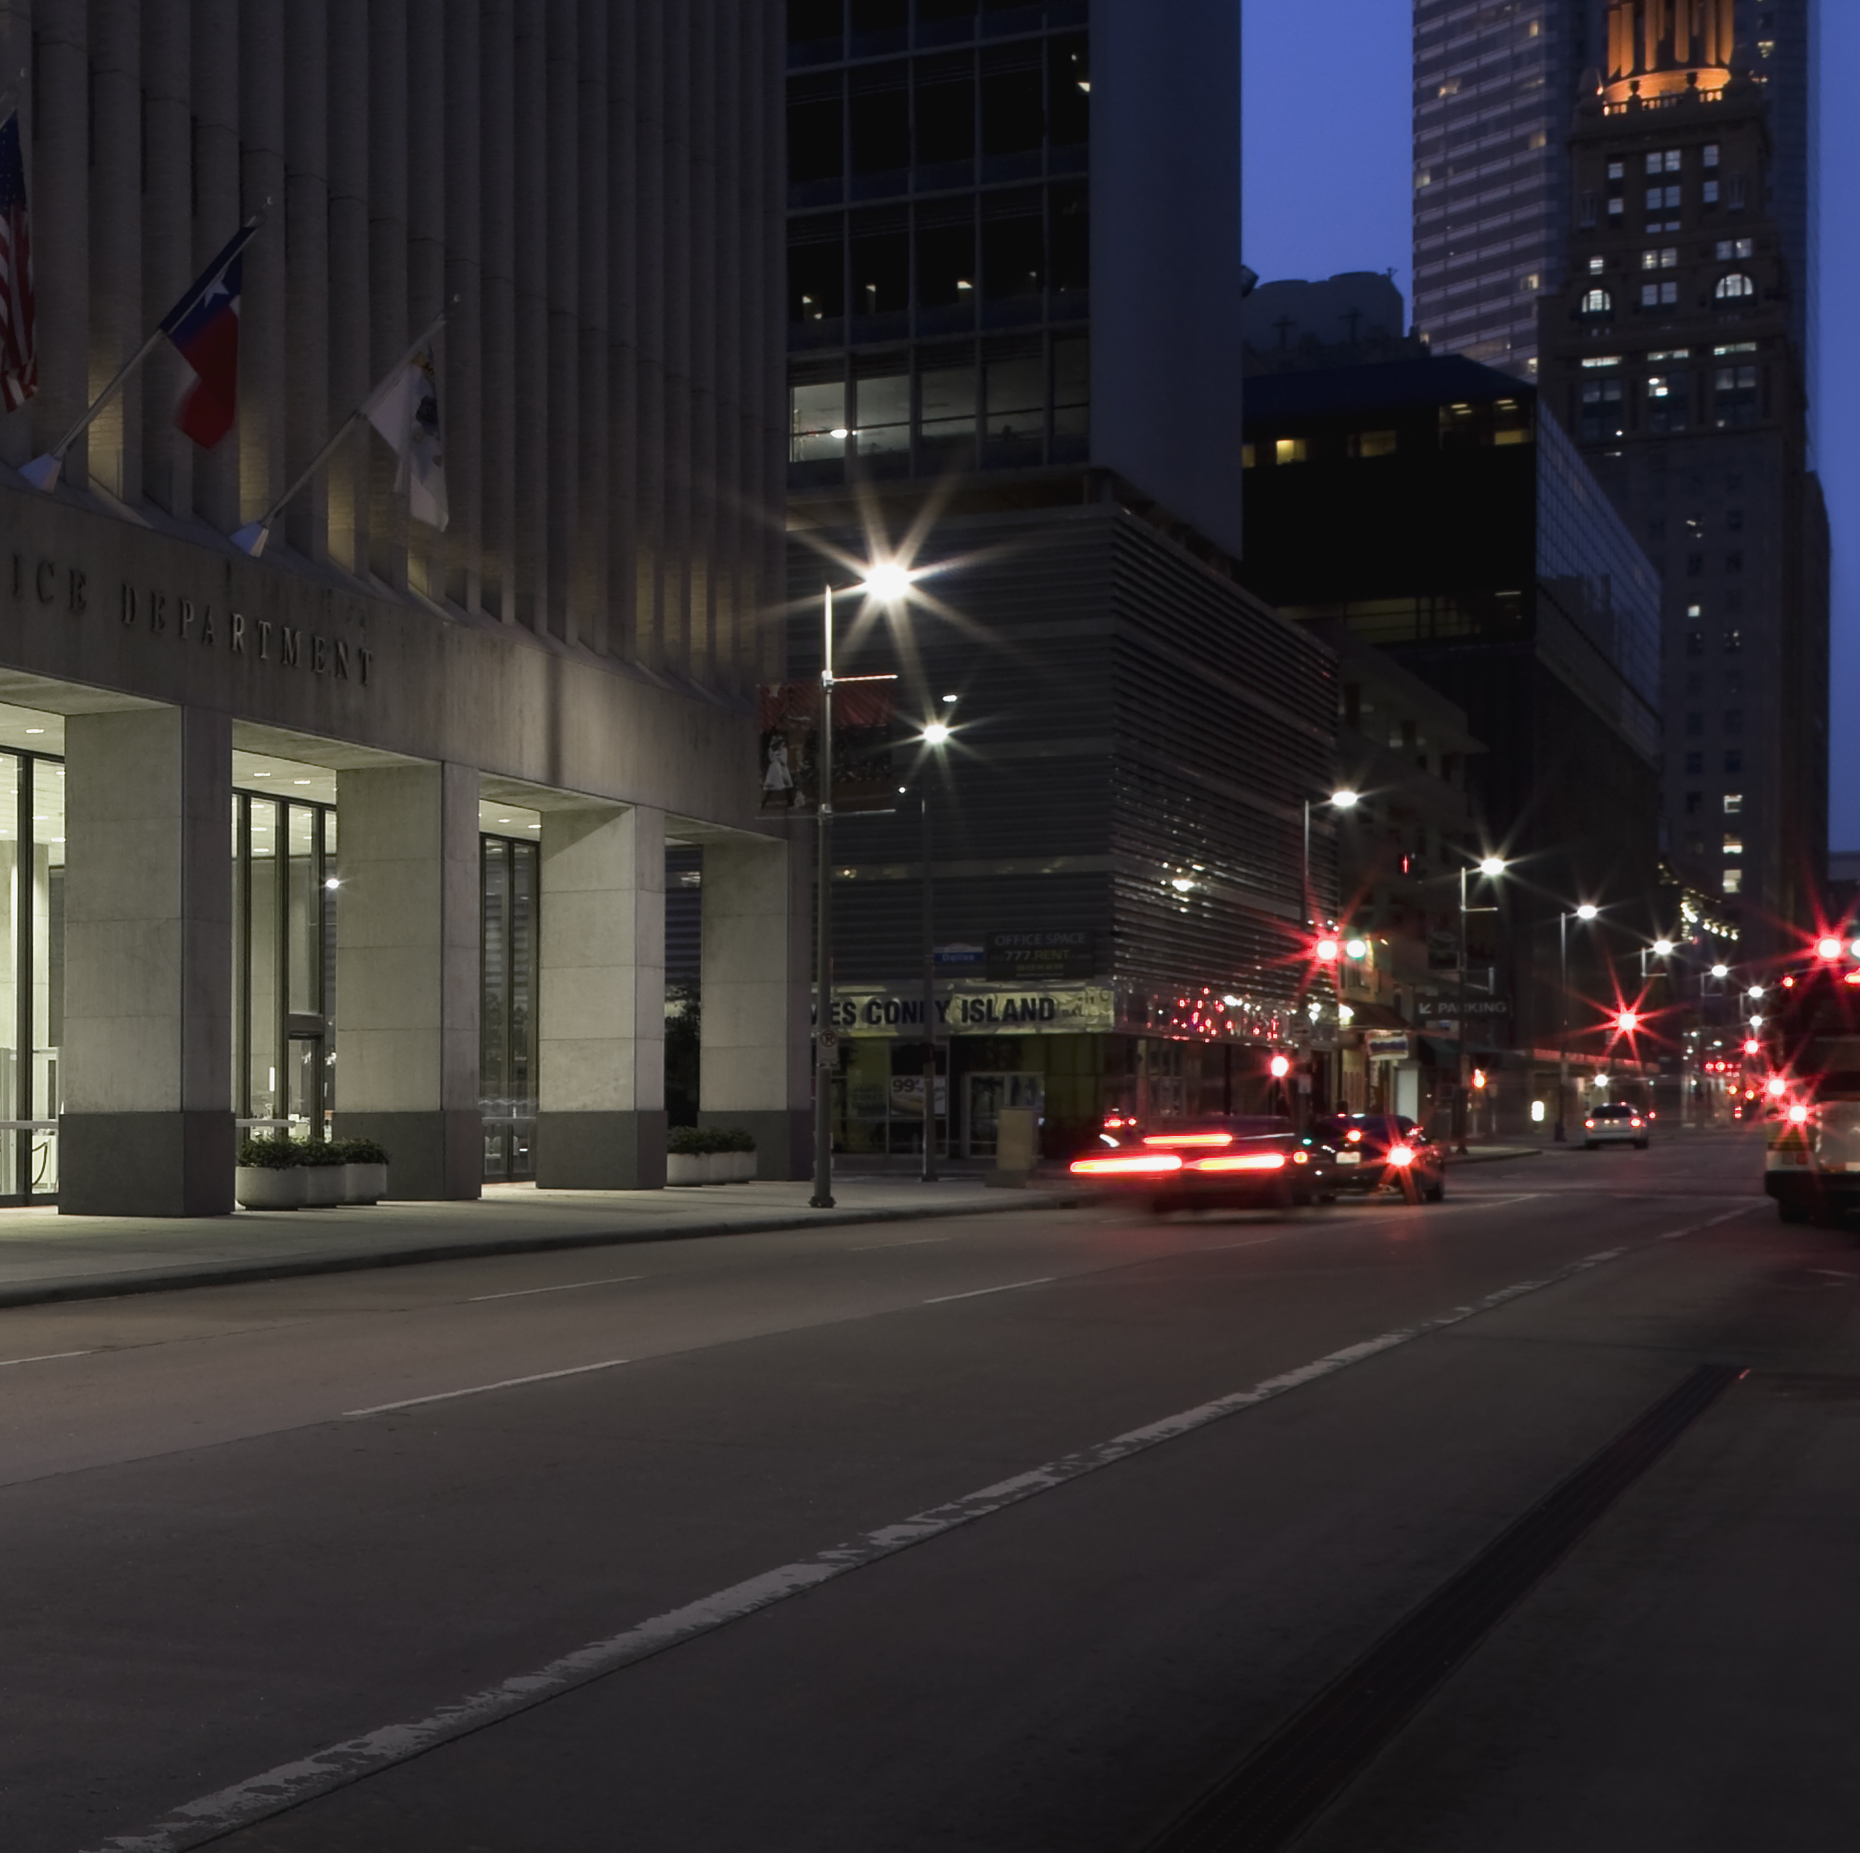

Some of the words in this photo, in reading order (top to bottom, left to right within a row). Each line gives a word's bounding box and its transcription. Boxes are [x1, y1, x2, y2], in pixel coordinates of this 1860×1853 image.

[120, 582, 377, 689] DEPARTMENT
[994, 933, 1042, 946] OFFICE
[1046, 932, 1086, 945] SPACE
[961, 997, 1055, 1023] ISLAND
